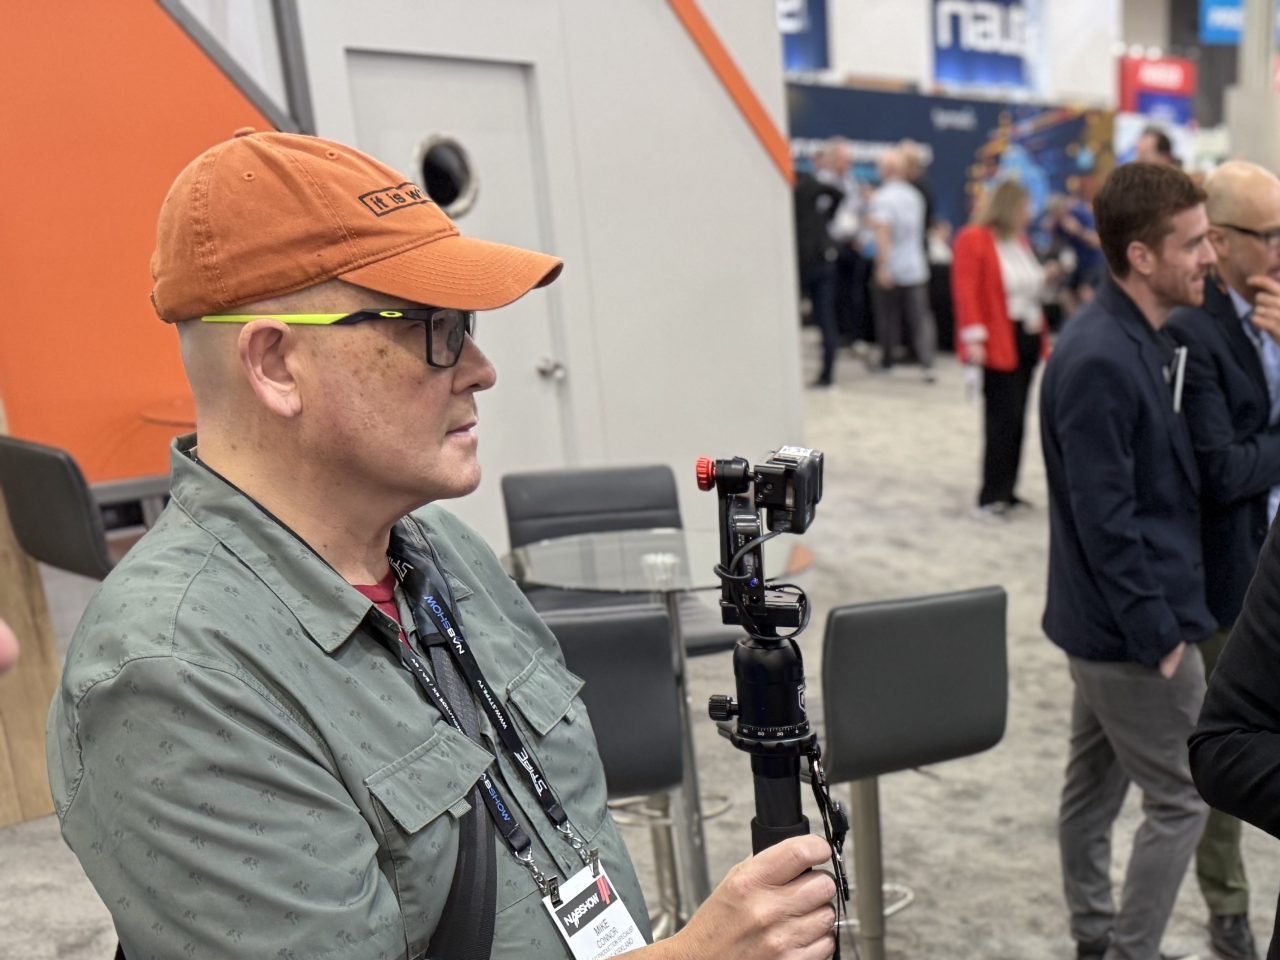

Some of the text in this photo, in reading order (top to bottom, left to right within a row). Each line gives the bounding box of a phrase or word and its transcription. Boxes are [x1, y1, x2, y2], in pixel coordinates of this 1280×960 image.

[370, 196, 389, 210] it
[386, 193, 406, 205] is
[424, 594, 465, 655] NABSHOW
[481, 772, 511, 822] ABSHOW
[563, 892, 600, 928] NABSHOW
[593, 918, 610, 936] MIKE
[596, 926, 619, 949] CONNOR
